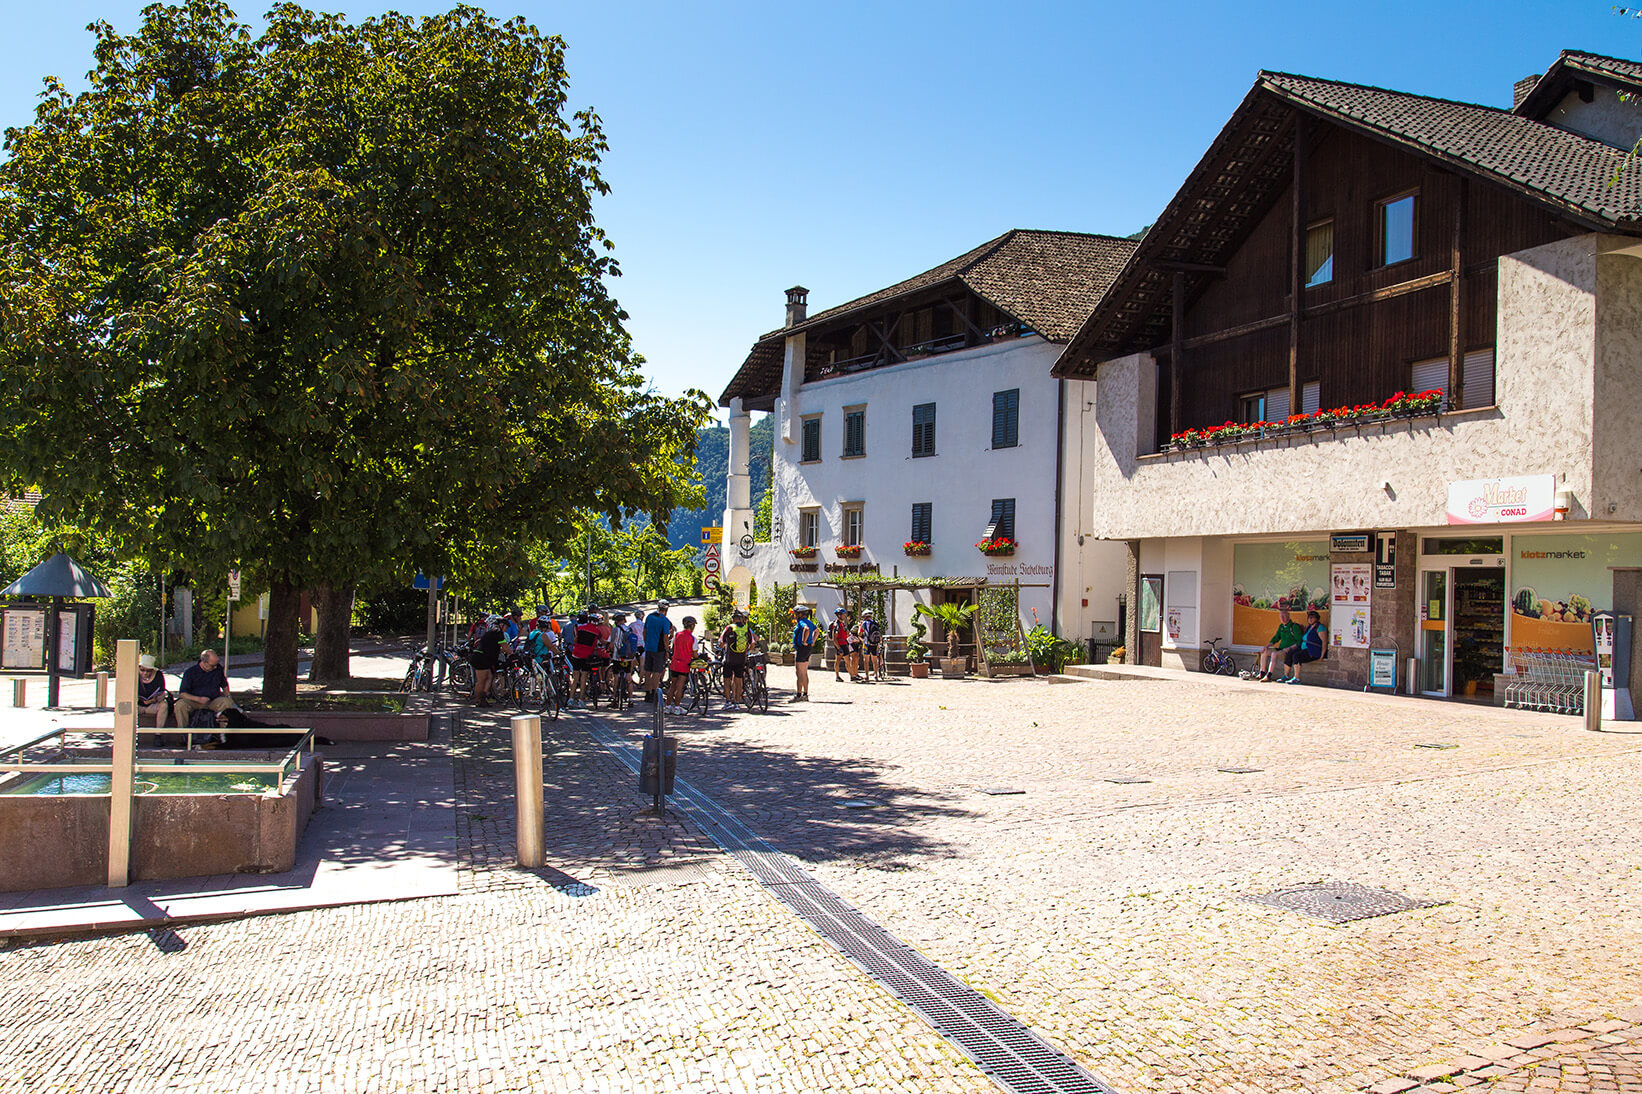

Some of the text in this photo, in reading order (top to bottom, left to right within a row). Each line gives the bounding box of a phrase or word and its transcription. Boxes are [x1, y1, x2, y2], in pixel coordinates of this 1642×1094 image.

[1483, 482, 1527, 505] Market
[1501, 508, 1527, 517] CONAD
[1296, 554, 1331, 562] klotzmark
[1521, 550, 1586, 559] klotzmarket
